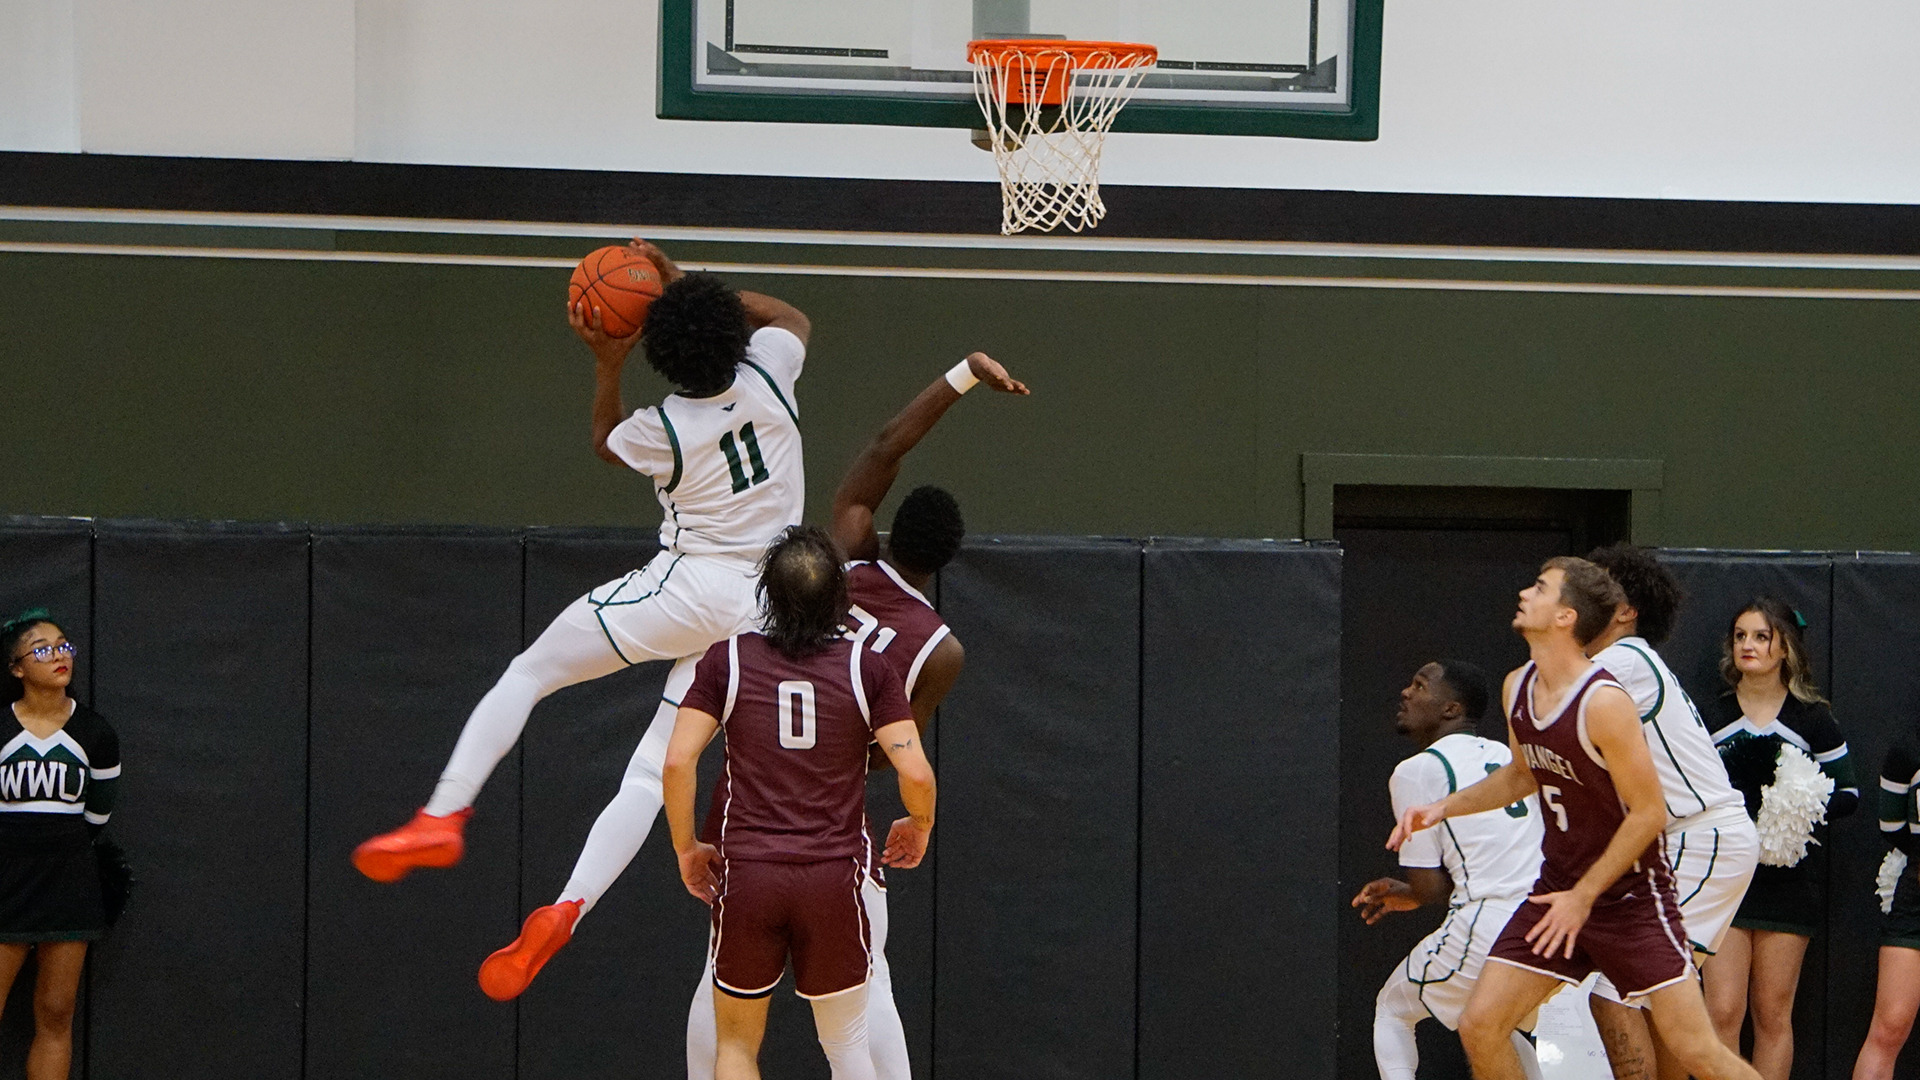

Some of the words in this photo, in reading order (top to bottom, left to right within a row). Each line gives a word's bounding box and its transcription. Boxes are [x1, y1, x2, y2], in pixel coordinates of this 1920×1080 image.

[719, 420, 769, 494] 11
[778, 681, 816, 749] 0
[0, 760, 85, 802] WWU
[1542, 785, 1569, 832] 5
